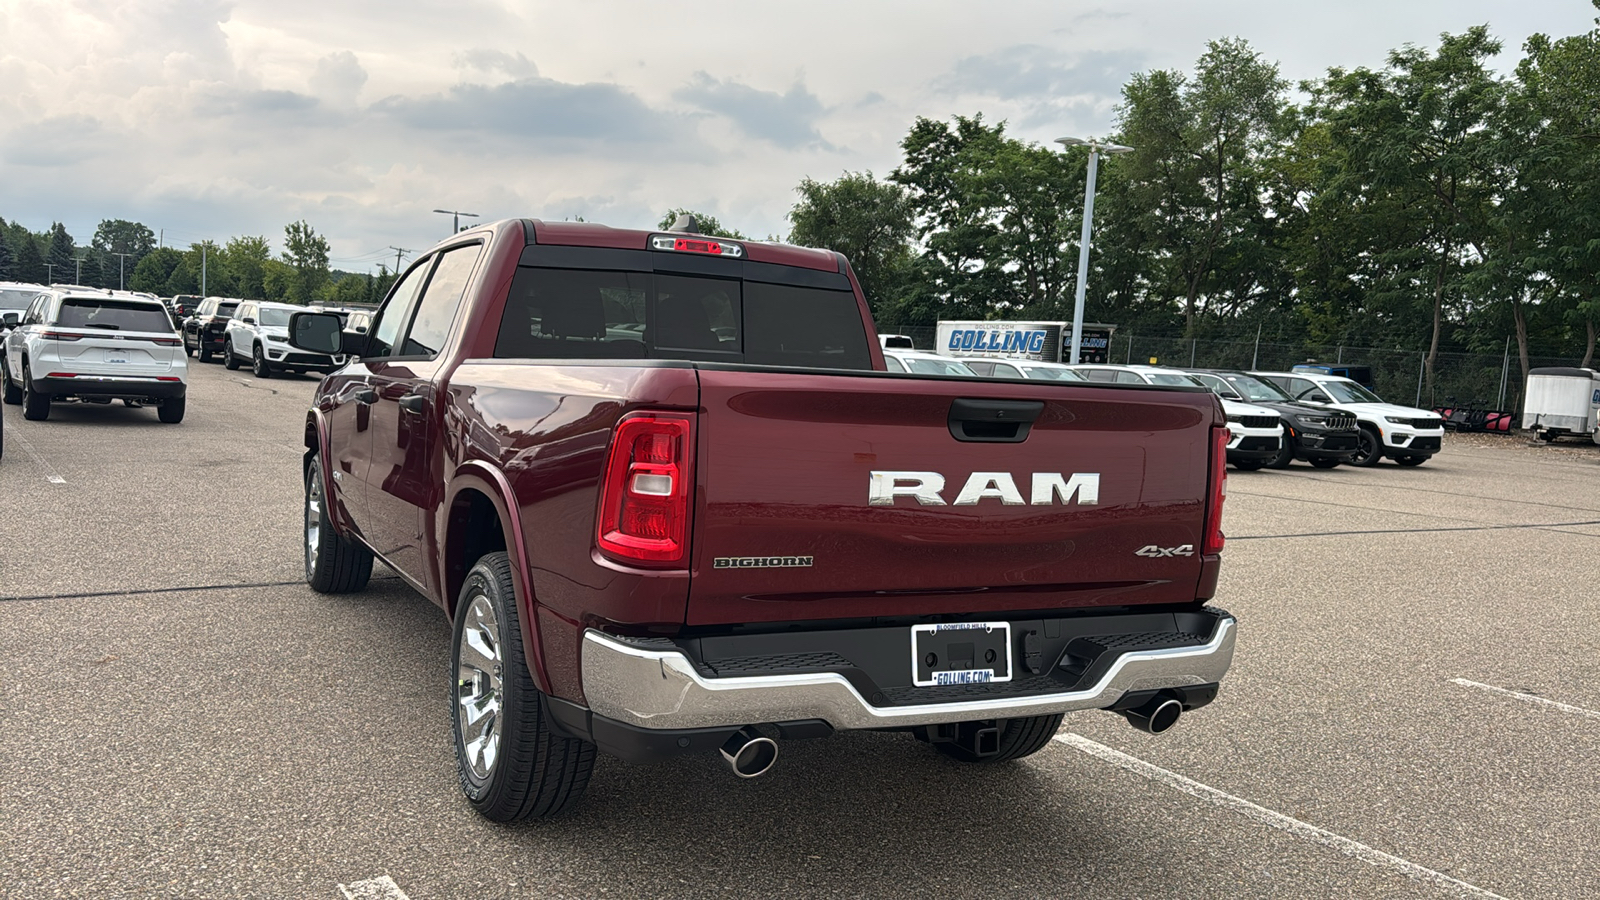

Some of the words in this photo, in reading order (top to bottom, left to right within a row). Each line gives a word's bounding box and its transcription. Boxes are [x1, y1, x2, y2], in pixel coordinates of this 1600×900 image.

[948, 330, 1047, 353] GOLLING
[1064, 336, 1107, 348] GLING
[868, 470, 1101, 506] RAM
[1134, 544, 1194, 558] 4x4
[713, 556, 813, 568] BIGHORN
[937, 671, 991, 685] GOLLING.COM
